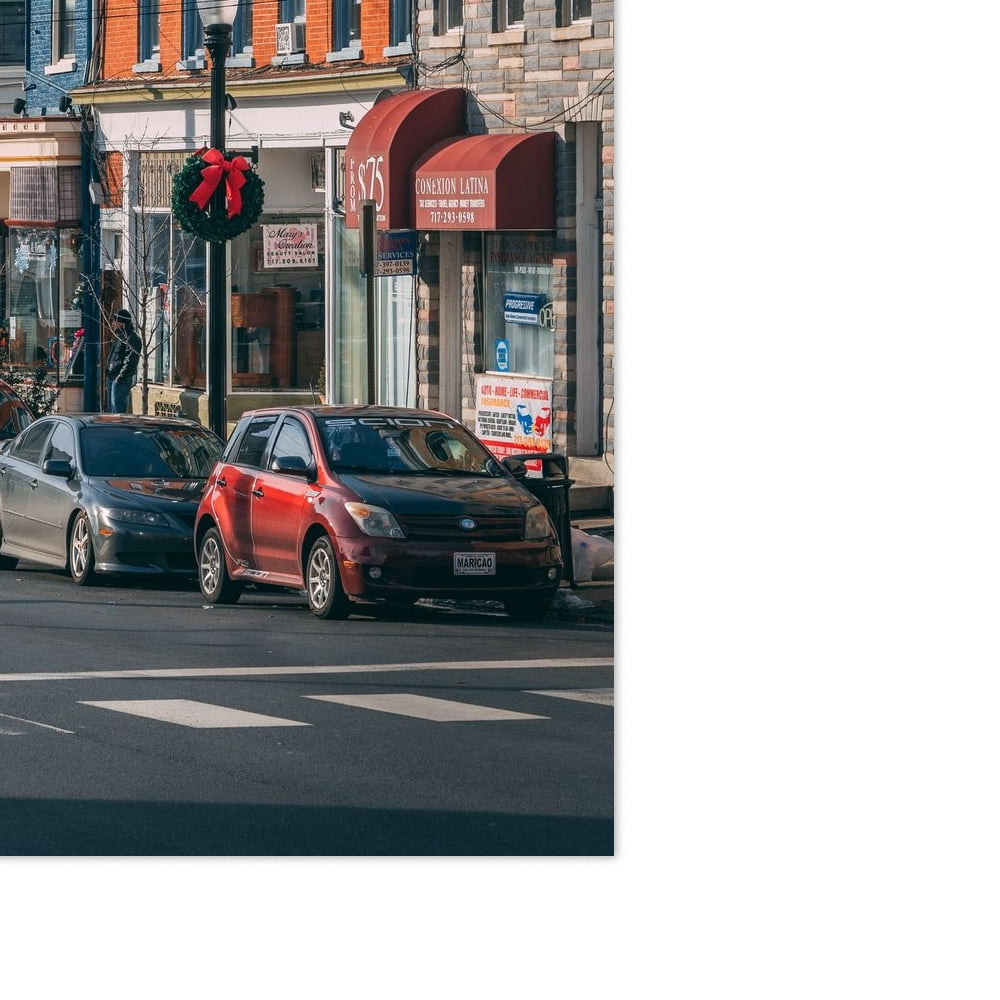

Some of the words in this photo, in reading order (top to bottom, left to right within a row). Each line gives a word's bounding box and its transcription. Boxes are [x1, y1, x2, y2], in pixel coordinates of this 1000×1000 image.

[358, 156, 384, 212] $75
[415, 178, 456, 194] CONEXION
[460, 177, 489, 194] LATINA
[457, 558, 493, 568] MARICAO
